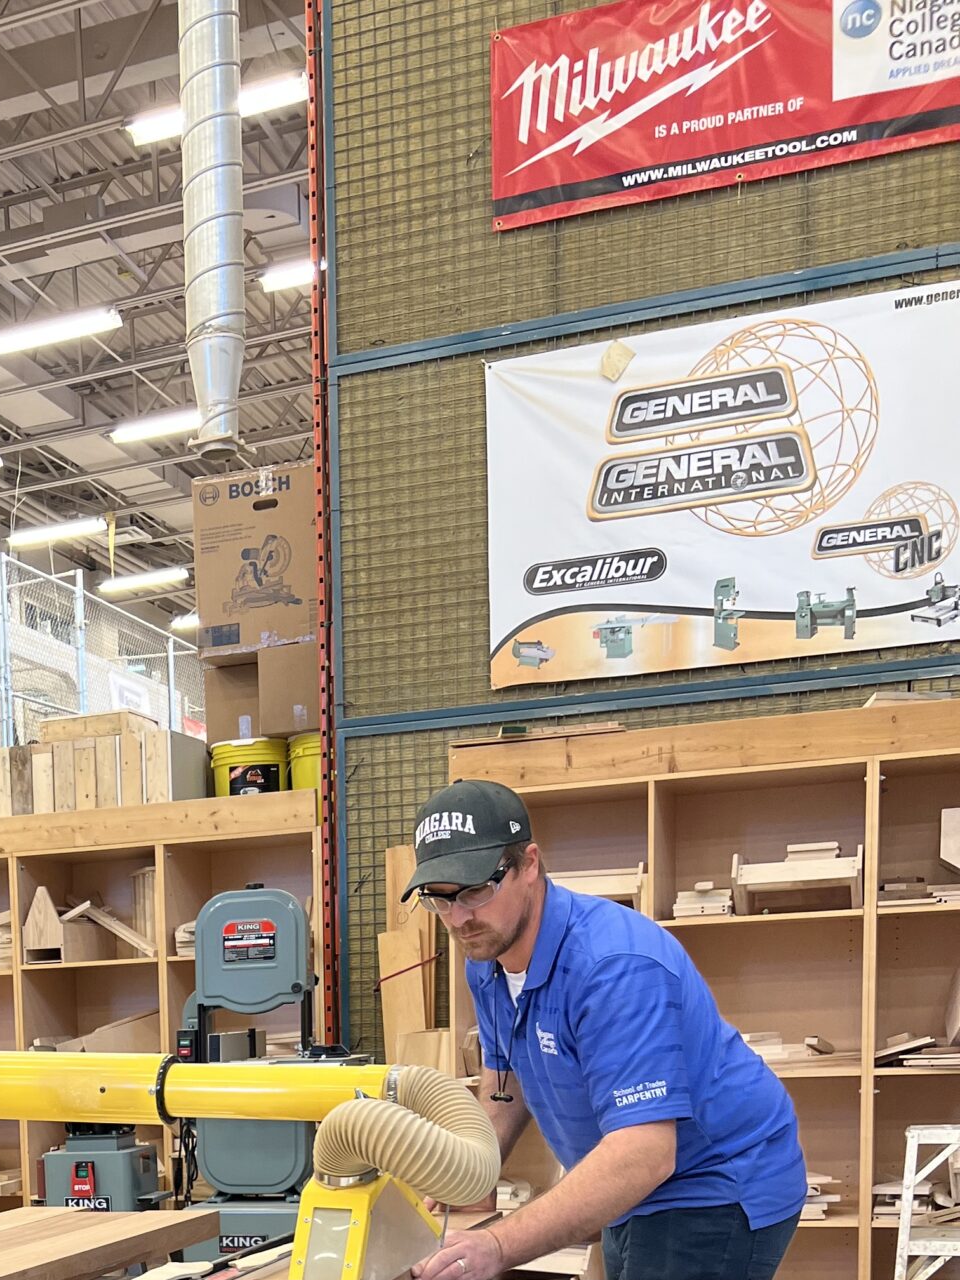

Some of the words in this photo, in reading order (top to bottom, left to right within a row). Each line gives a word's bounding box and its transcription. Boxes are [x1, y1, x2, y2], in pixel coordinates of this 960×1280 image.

[500, 0, 772, 145] Milwaukee
[654, 125, 667, 139] IS
[670, 122, 680, 136] A
[682, 113, 725, 134] PROUD
[727, 102, 785, 124] PARTNER
[787, 97, 805, 112] OF
[622, 129, 858, 188] WWW.MILWAUKEETOOL.COM
[621, 381, 781, 425] GENERAL
[606, 440, 796, 490] GENERAL
[228, 474, 290, 500] BOSH
[821, 523, 920, 548] GENERAL
[894, 528, 942, 573] CNC
[532, 555, 659, 589] Excalibur
[237, 923, 260, 931] KING
[613, 1085, 635, 1097] School
[615, 1086, 668, 1107] CARPENTRY
[68, 1198, 108, 1209] KING
[222, 1236, 264, 1247] KING
